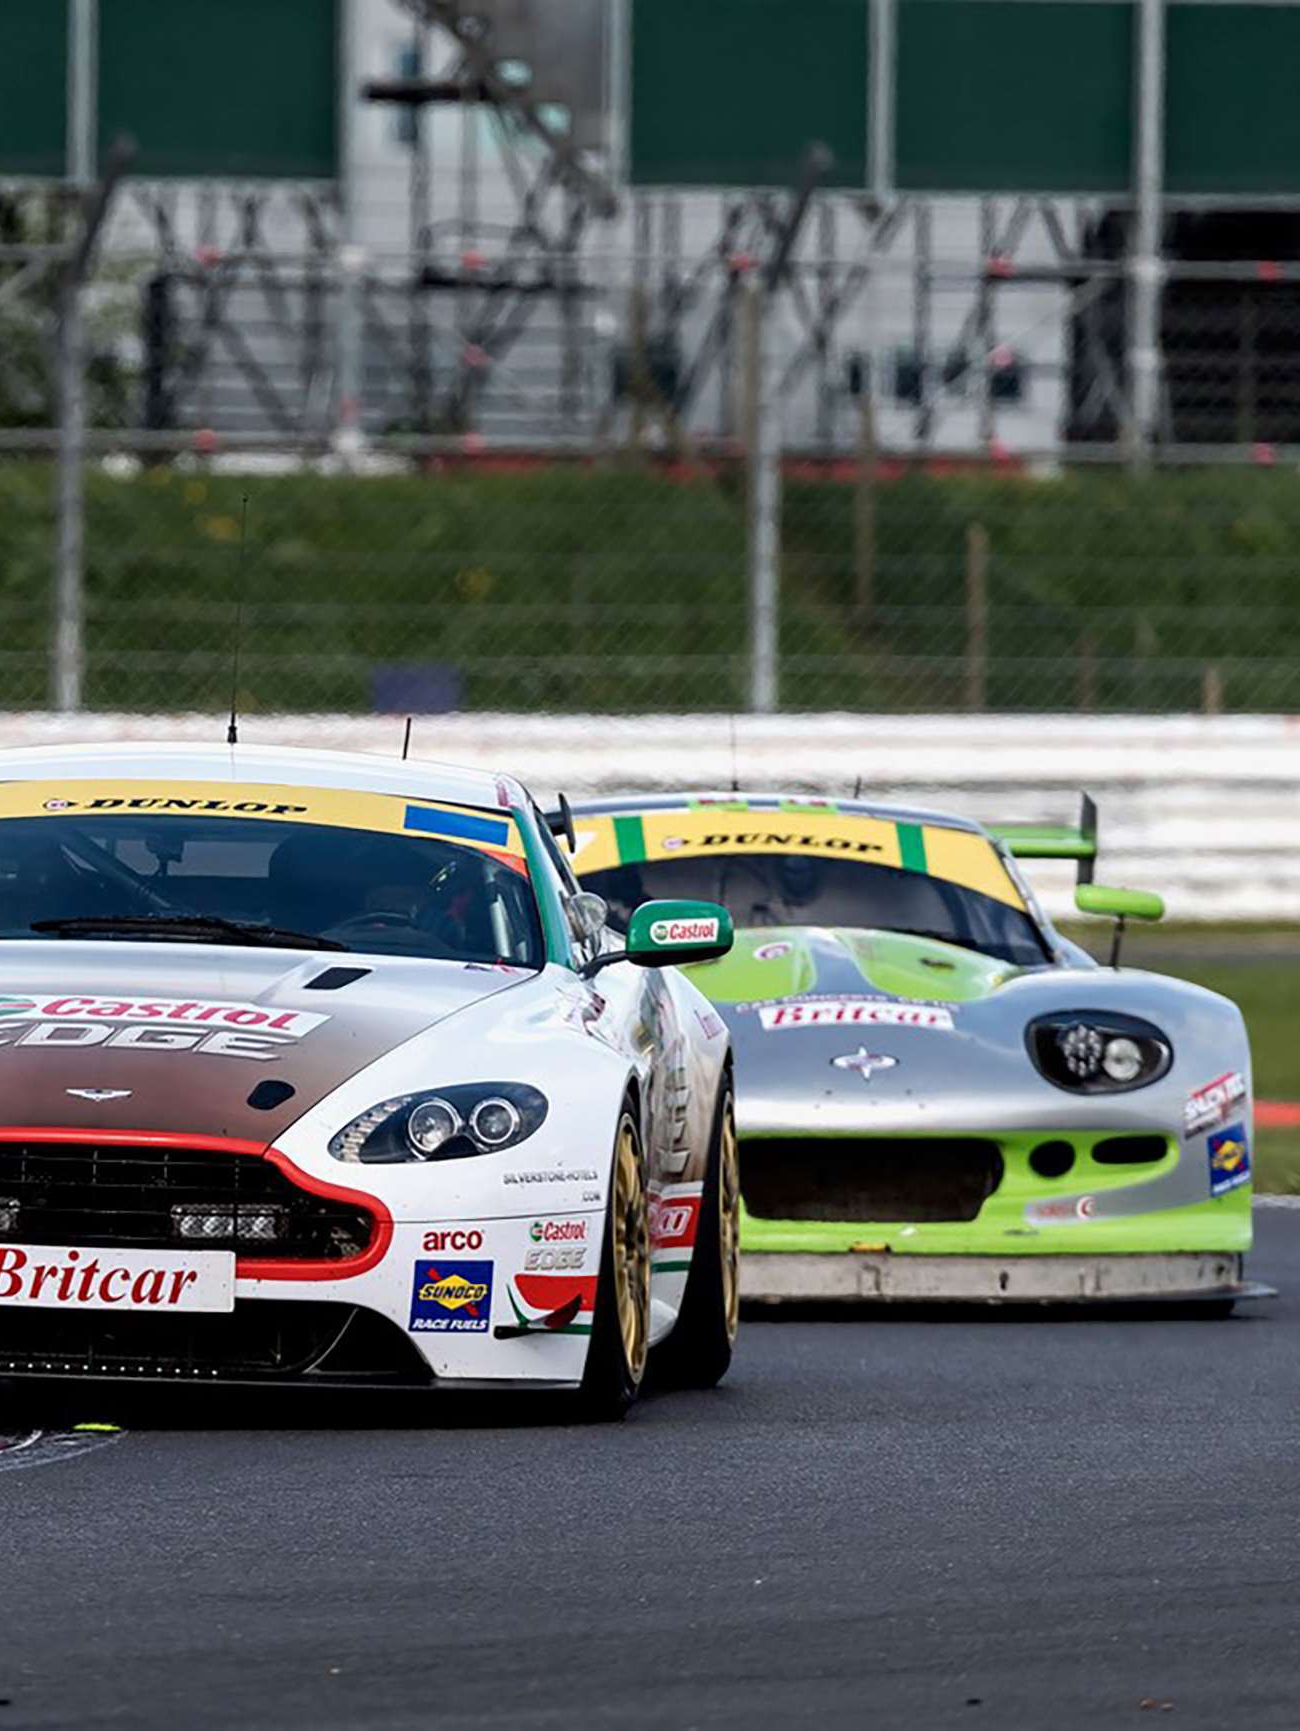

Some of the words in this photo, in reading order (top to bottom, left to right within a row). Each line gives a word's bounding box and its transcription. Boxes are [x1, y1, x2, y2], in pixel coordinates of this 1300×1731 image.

[84, 798, 308, 815] DUNLOP
[701, 832, 884, 853] DUNLOP
[669, 922, 715, 940] Castrol
[41, 996, 301, 1031] Castrol
[772, 1005, 949, 1026] Britcar
[422, 1230, 483, 1252] arco
[543, 1220, 586, 1241] Castrol
[523, 1247, 588, 1272] EDGE
[421, 1284, 485, 1300] SUNOCO
[411, 1318, 450, 1330] RACE
[449, 1318, 488, 1330] FUELS
